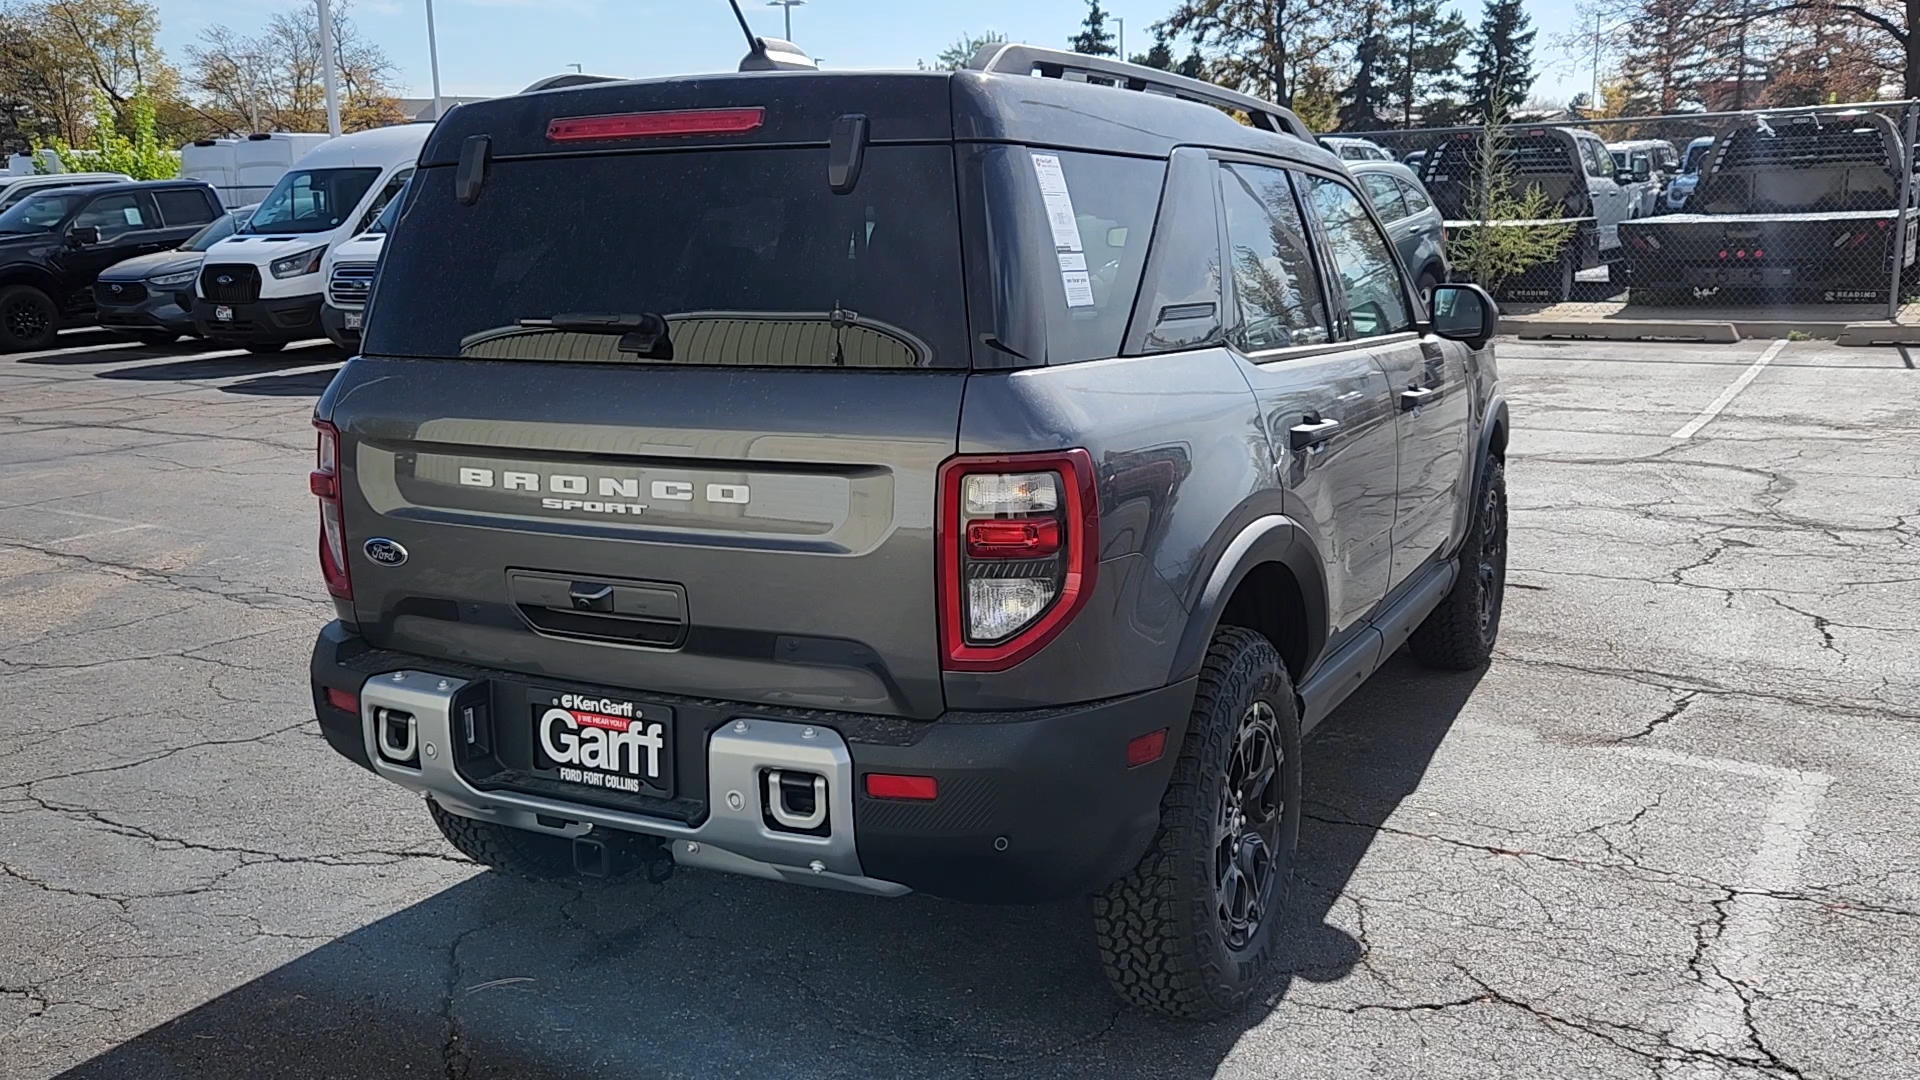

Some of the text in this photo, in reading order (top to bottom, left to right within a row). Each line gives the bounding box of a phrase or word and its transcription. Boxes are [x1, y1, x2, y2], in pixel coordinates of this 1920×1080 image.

[459, 466, 750, 504] BRONCO
[541, 497, 649, 515] SPORT
[371, 543, 396, 561] Ford
[573, 694, 633, 717] Ken Garff
[581, 715, 623, 728] WE HEAR YOU
[540, 708, 663, 778] Garff
[560, 767, 639, 792] FORD FORT COLLINS
